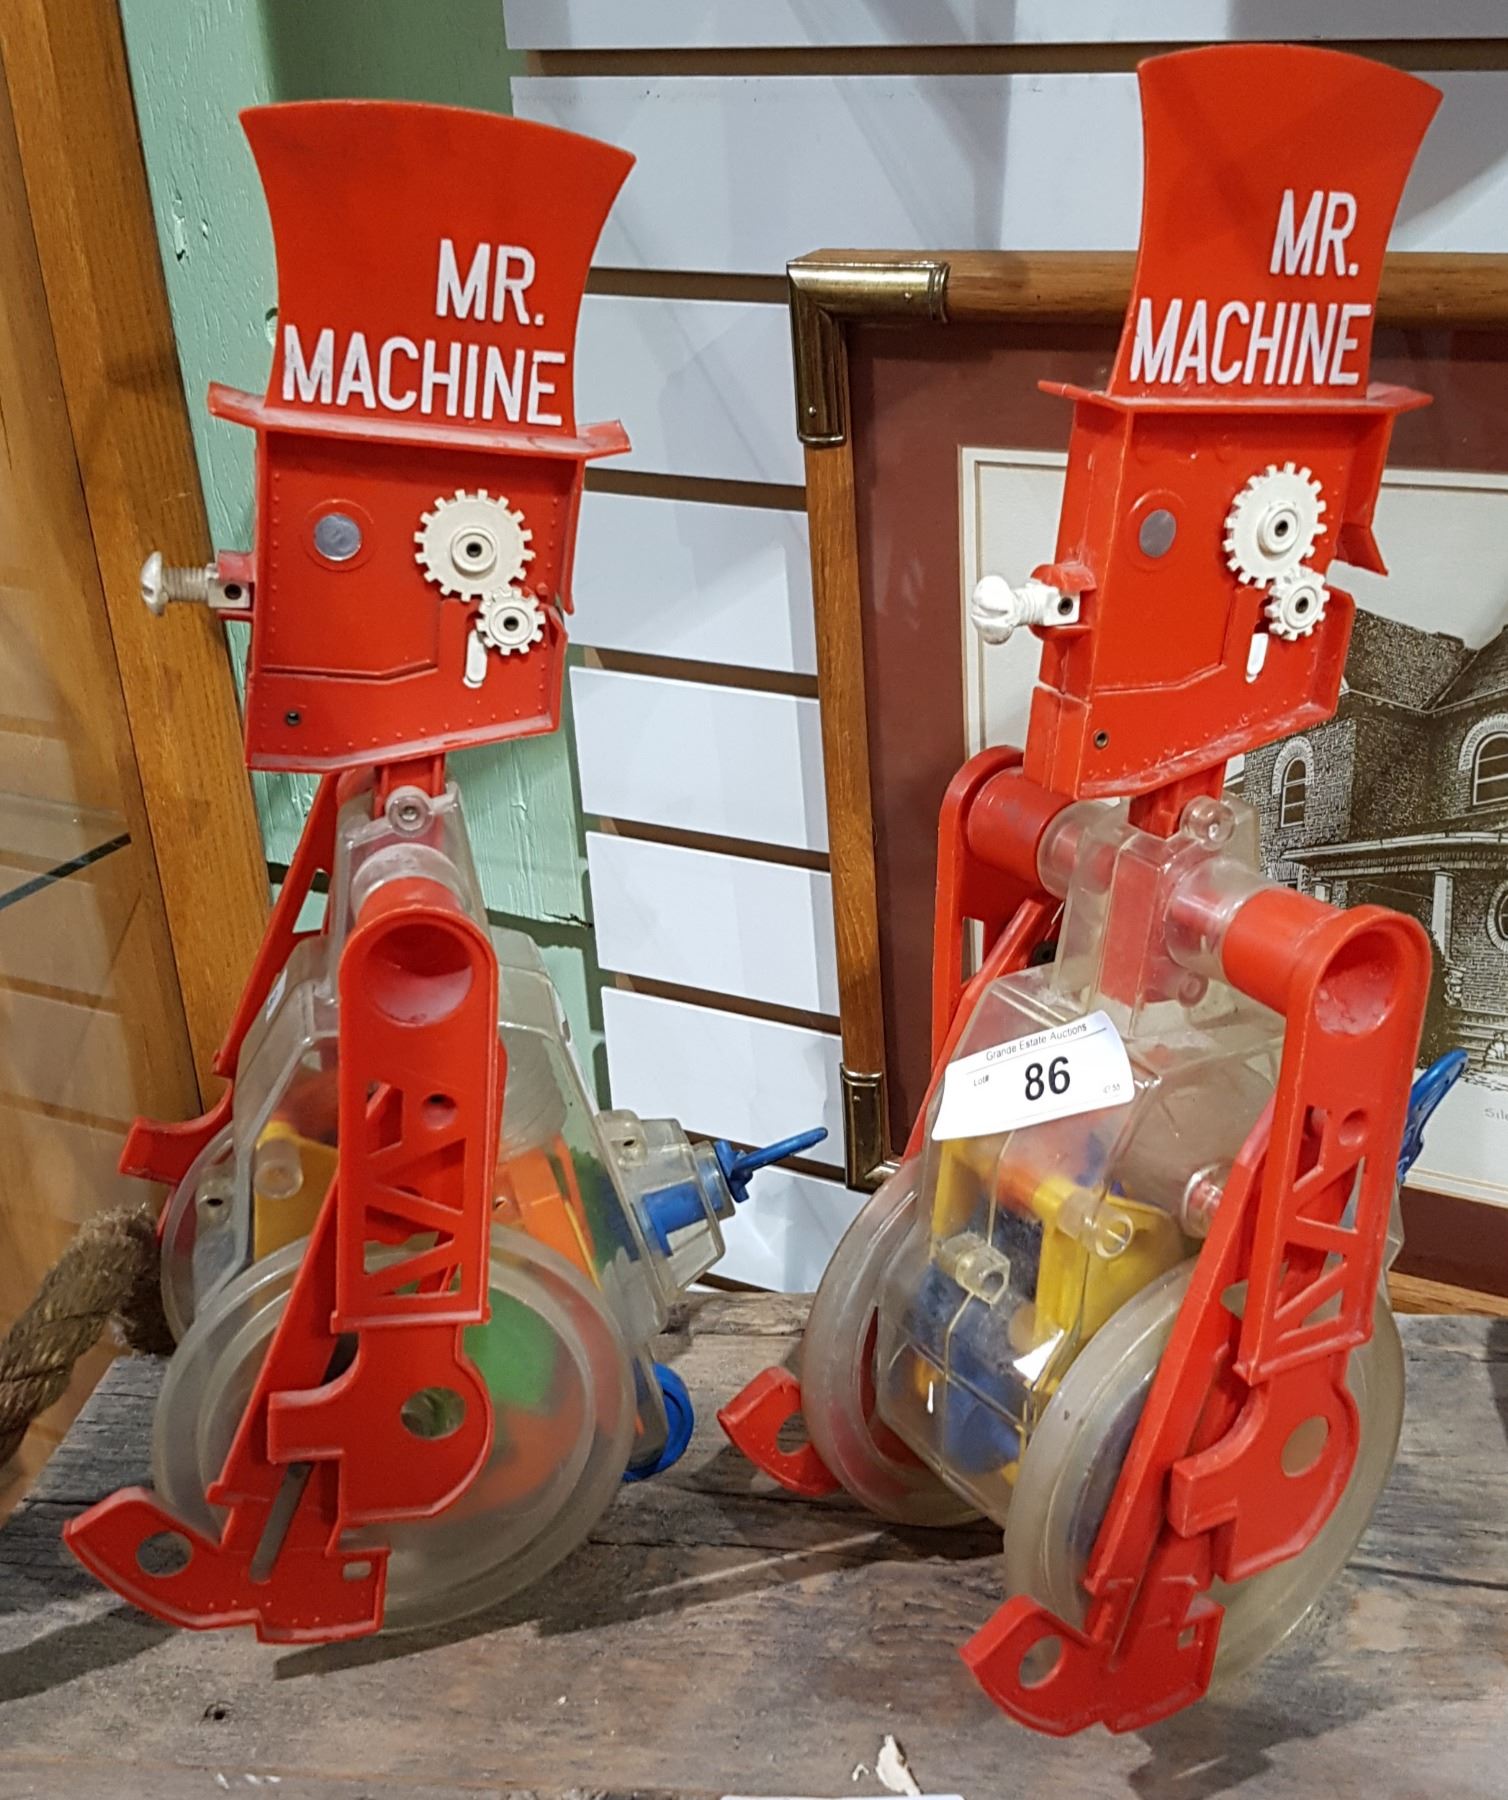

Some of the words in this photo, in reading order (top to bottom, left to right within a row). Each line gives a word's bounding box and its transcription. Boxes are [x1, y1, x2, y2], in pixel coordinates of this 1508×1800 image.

[1269, 188, 1359, 277] MR.
[435, 238, 545, 326] MR.
[282, 324, 567, 427] MACHINE
[1129, 297, 1372, 386] MACHINE
[986, 1044, 1017, 1061] Grande
[1019, 1036, 1047, 1051] Estate
[1049, 1022, 1088, 1041] Auctions
[1024, 1056, 1071, 1101] 86
